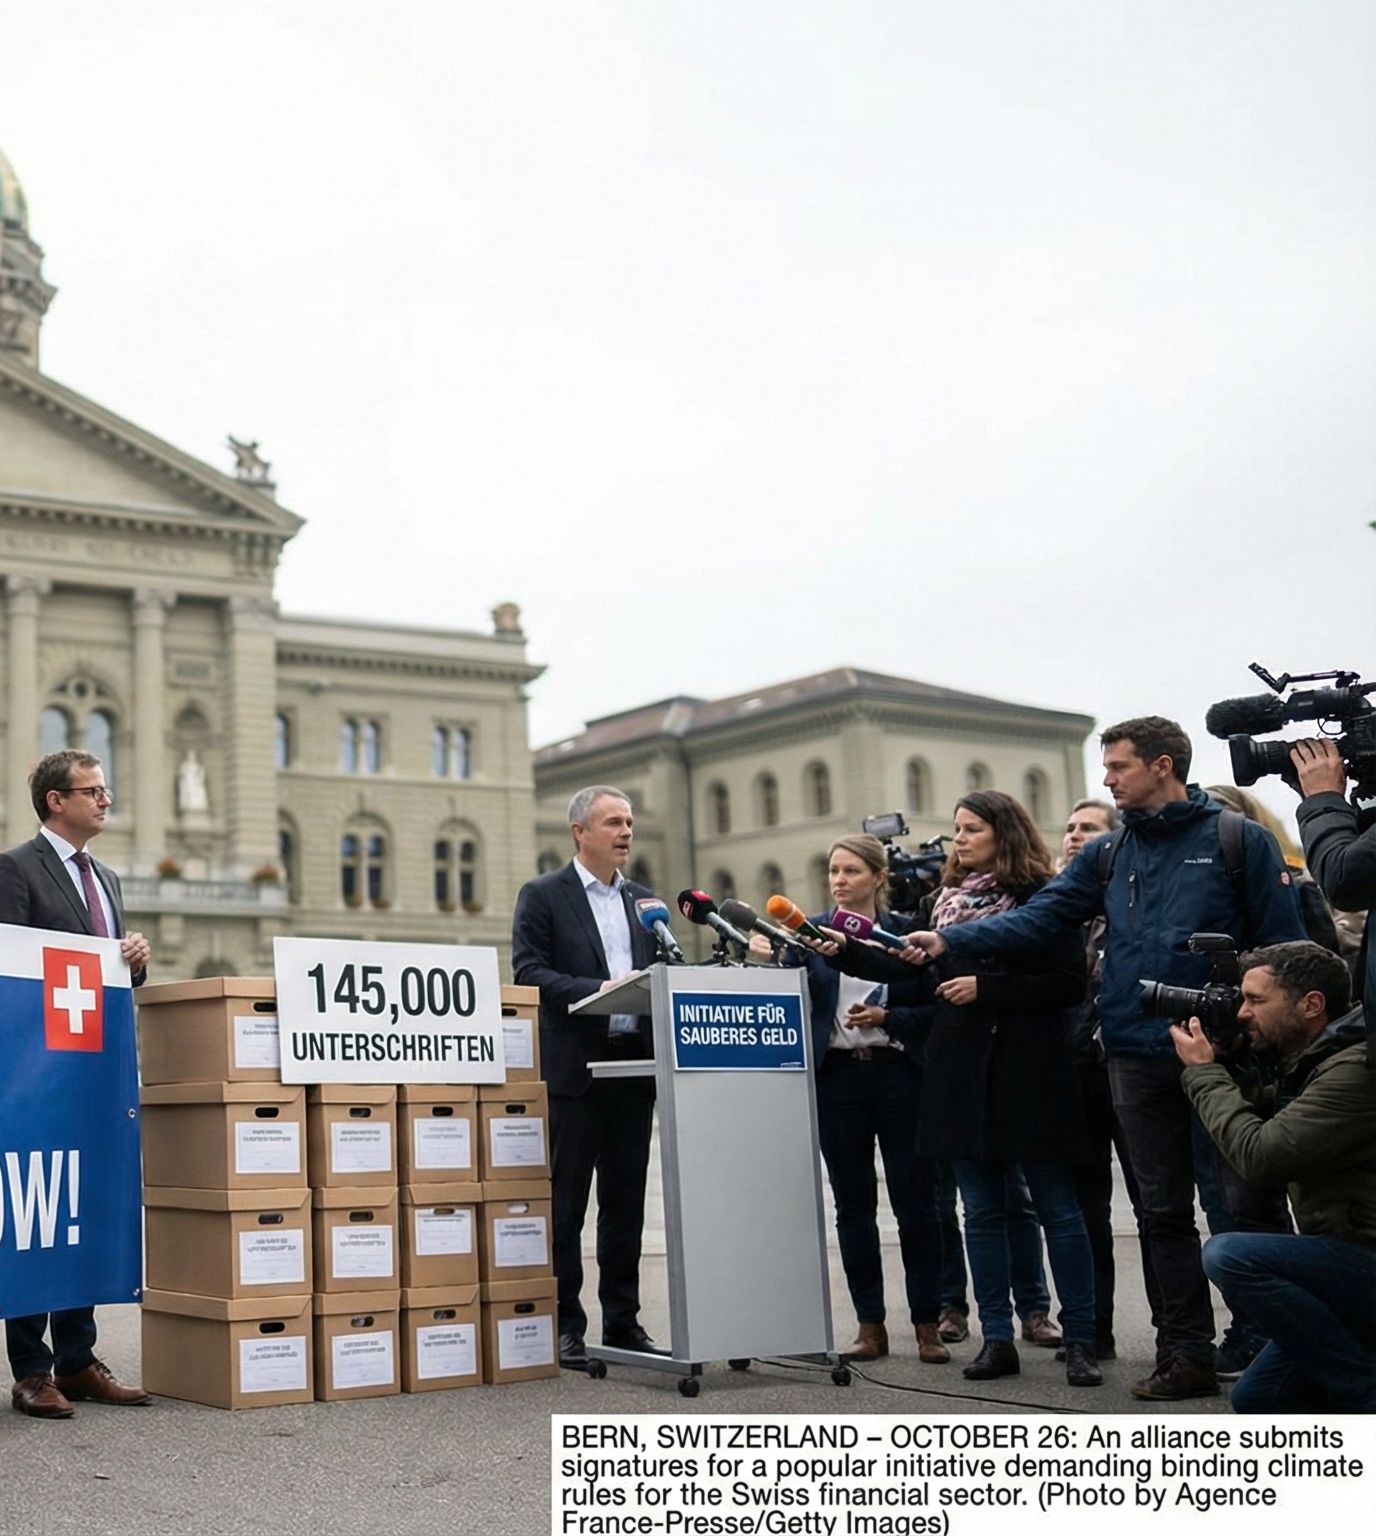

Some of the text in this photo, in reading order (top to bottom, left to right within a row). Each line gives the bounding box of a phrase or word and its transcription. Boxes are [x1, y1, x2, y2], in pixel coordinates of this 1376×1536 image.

[307, 963, 476, 1026] 145,000
[680, 1002, 786, 1025] INITIATIVE FÜR
[292, 1032, 495, 1062] UNTERSCHRIFTEN
[680, 1026, 798, 1046] SAUBERES GELD
